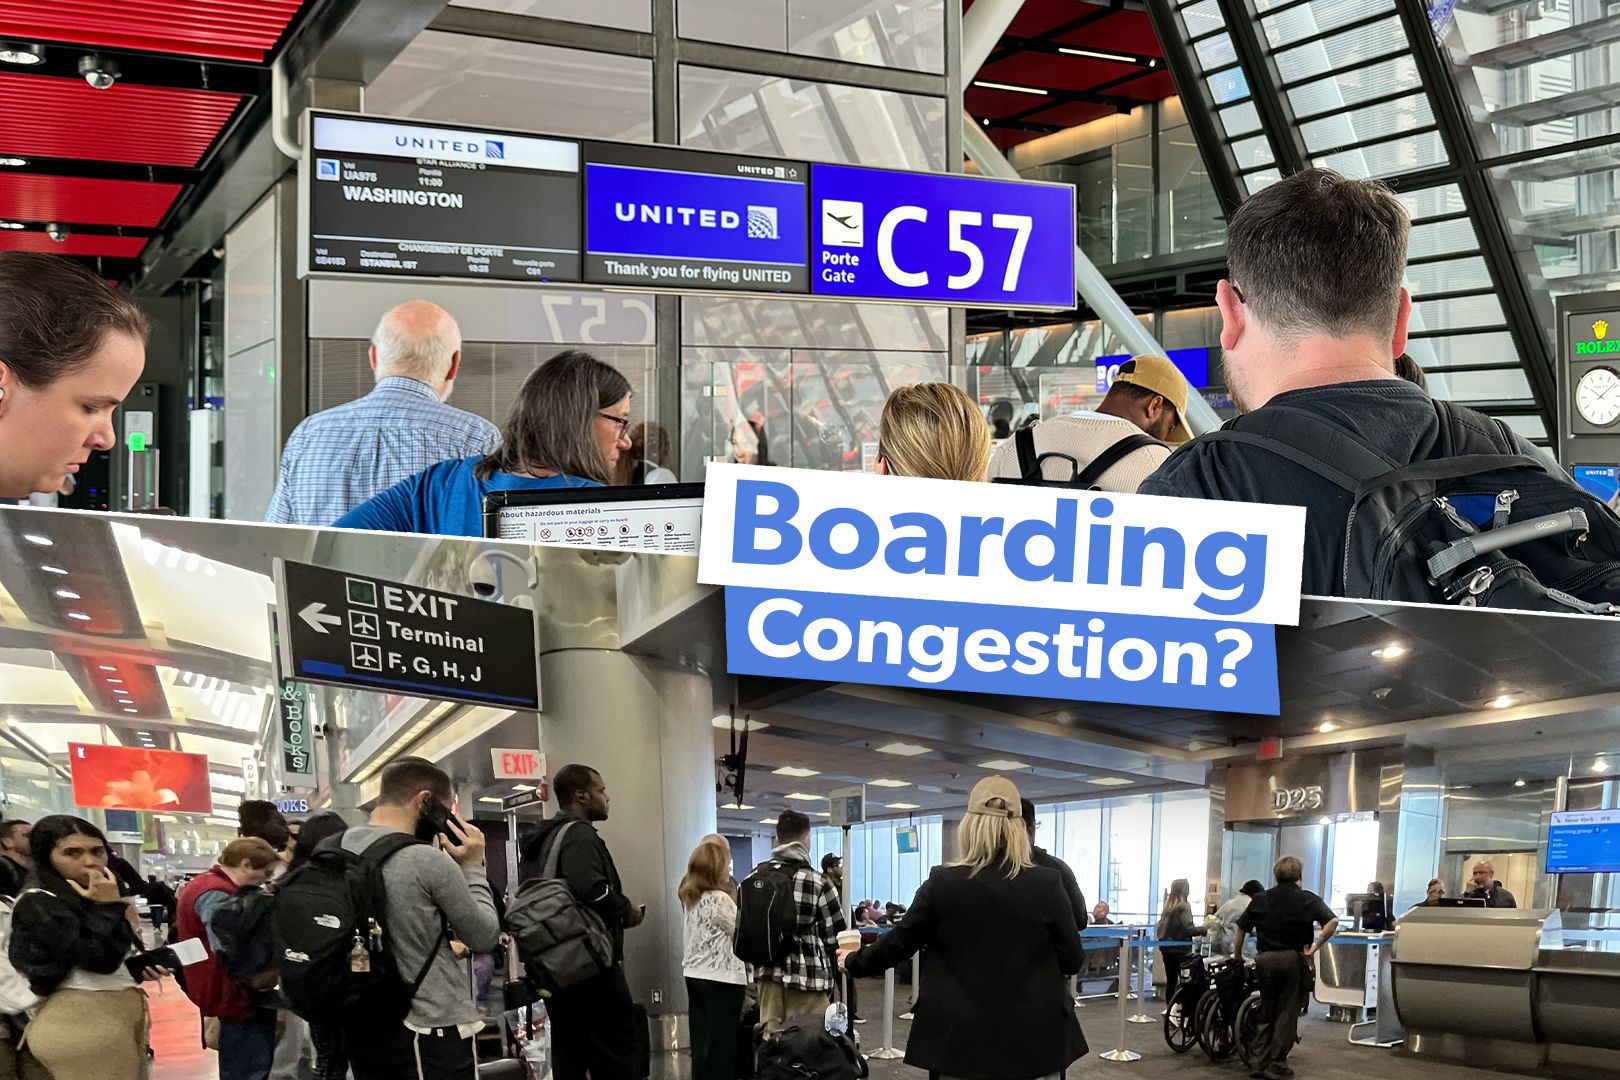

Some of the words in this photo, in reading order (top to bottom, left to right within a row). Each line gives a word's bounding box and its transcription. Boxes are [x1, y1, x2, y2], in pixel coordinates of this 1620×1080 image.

[395, 136, 479, 153] UNITED
[737, 165, 774, 176] UNITED
[342, 186, 463, 208] WASHINGTON
[615, 203, 740, 229] UNITED
[822, 251, 859, 266] Porte
[877, 206, 929, 287] C
[947, 210, 1033, 292] 57
[604, 260, 649, 276] Thank
[651, 265, 678, 279] you
[680, 265, 700, 278] for
[702, 266, 740, 283] flying
[742, 268, 792, 283] UNITED
[822, 268, 856, 283] Gate
[525, 509, 564, 517] hazardous
[565, 507, 601, 515] materials
[383, 585, 458, 621] EXIT
[386, 620, 484, 653] Terminal
[388, 651, 407, 674] F,
[412, 656, 437, 678] G,
[443, 661, 465, 682] H,
[470, 666, 482, 682] J
[283, 686, 302, 701] &
[502, 752, 533, 775] EXIT
[1274, 785, 1322, 812] D25
